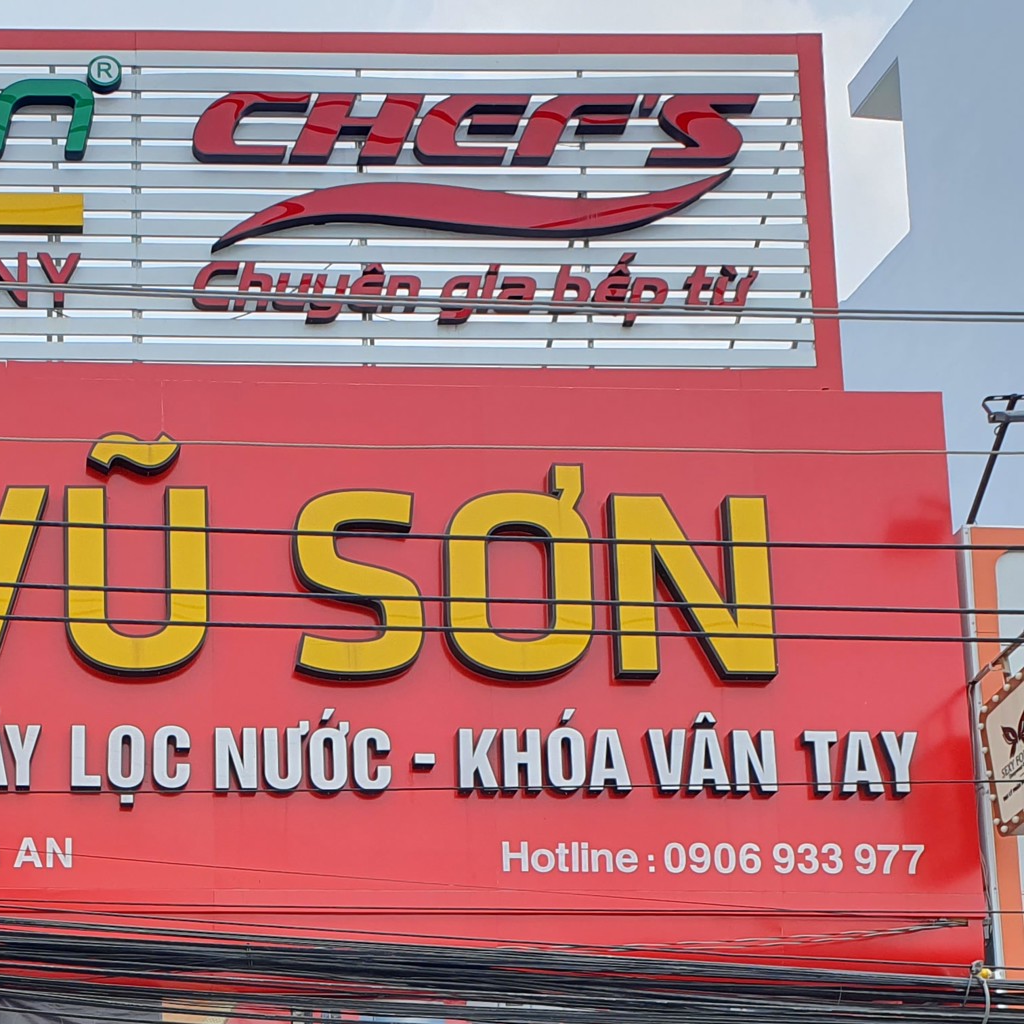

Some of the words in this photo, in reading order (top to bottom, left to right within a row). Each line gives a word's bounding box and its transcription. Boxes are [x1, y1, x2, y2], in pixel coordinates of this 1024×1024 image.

[192, 92, 760, 166] CHEF'S
[192, 260, 420, 325] Chuyên
[436, 263, 537, 325] gia
[550, 252, 670, 327] bếp
[683, 259, 756, 310] từ
[292, 462, 778, 685] SƠN
[70, 724, 191, 808] LỌC
[213, 708, 392, 795] NƯỚC
[453, 708, 633, 796] KHÓA
[646, 711, 778, 796] VÂN
[803, 730, 918, 796] TAY
[13, 837, 73, 869] AN
[501, 840, 634, 873] Hotline
[664, 843, 762, 875] 0906
[772, 843, 843, 875] 933
[855, 844, 925, 876] 977
